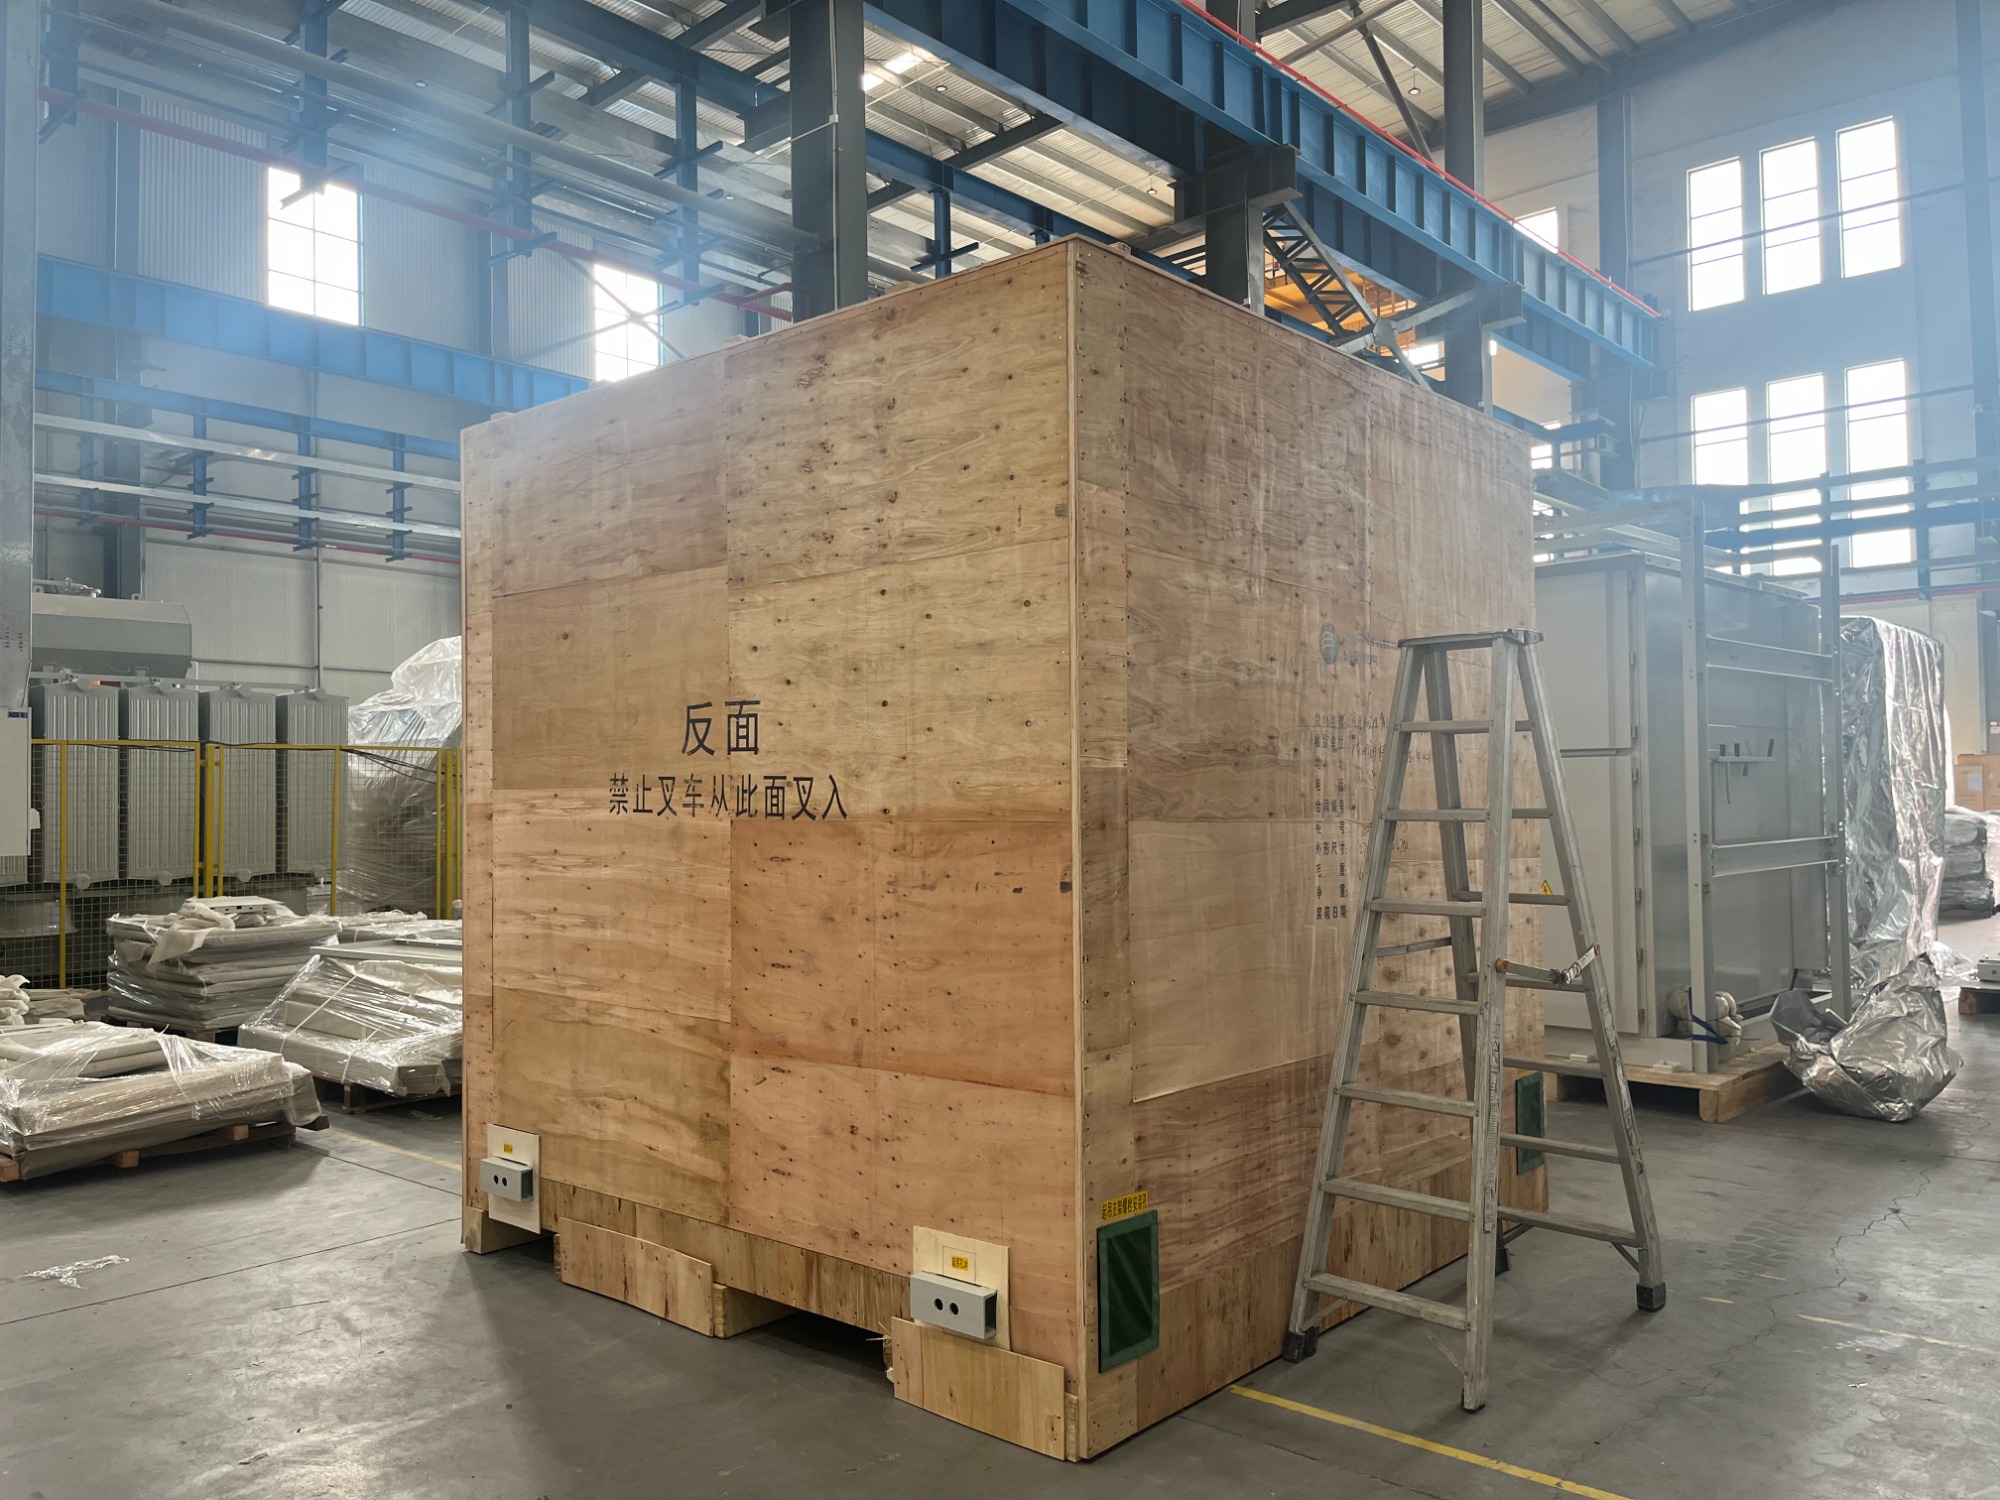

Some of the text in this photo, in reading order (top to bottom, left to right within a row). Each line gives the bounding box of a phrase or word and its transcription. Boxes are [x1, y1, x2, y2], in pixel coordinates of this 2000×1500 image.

[681, 700, 761, 756] 反面
[609, 773, 848, 821] 禁止叉车从此面叉入
